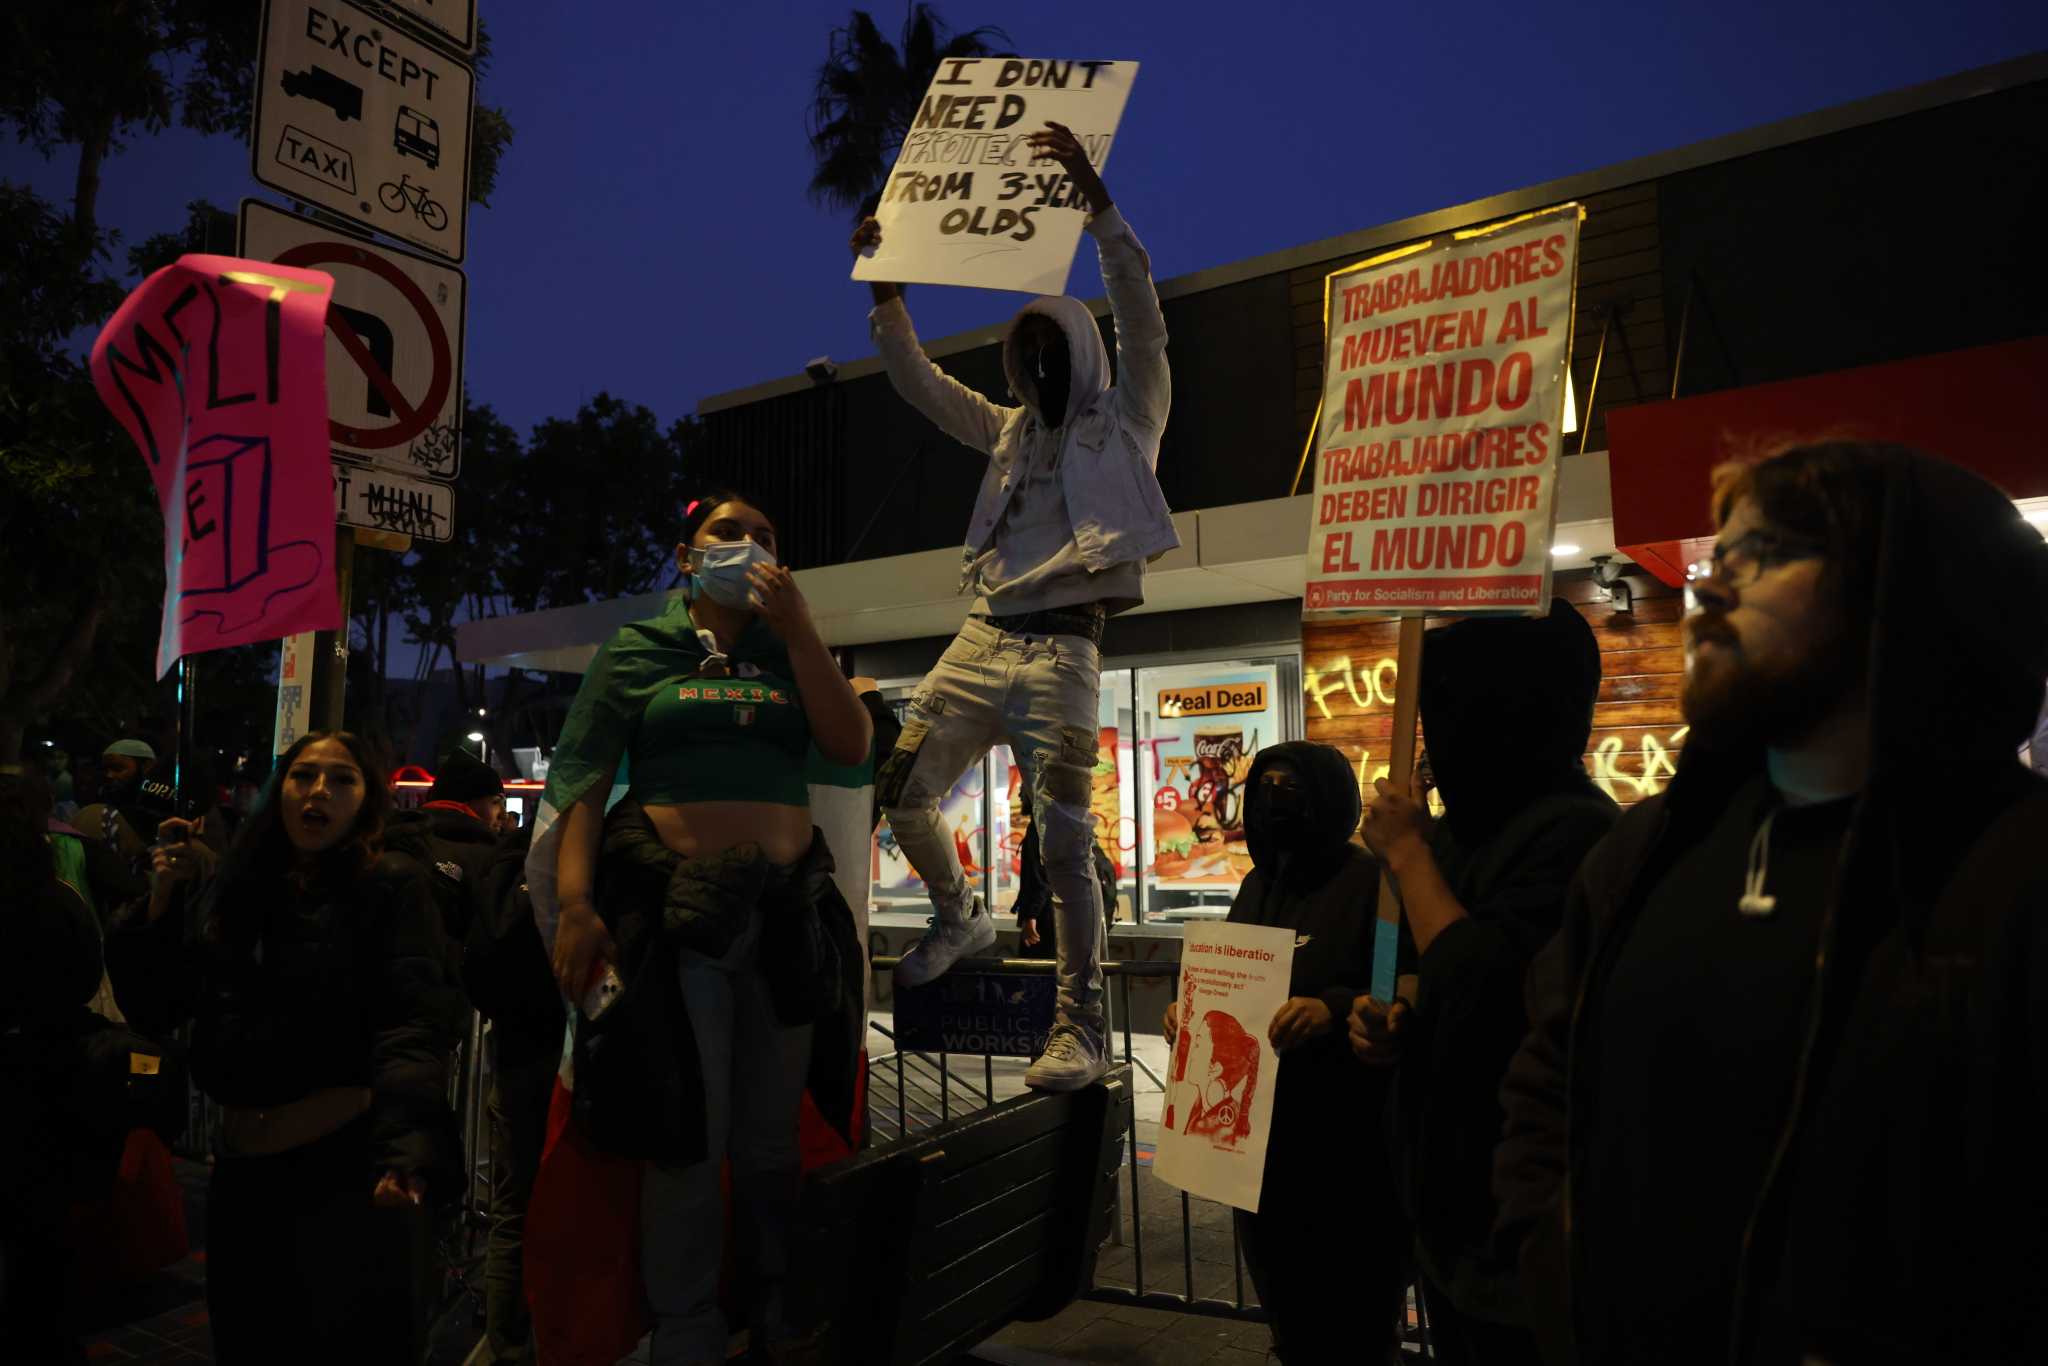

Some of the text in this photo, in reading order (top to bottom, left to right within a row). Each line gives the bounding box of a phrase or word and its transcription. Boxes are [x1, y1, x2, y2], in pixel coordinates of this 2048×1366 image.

[306, 9, 439, 100] EXCEPT
[936, 60, 981, 85] I
[917, 94, 1026, 129] NEED
[287, 138, 349, 182] TAXI
[887, 171, 974, 203] FROM
[940, 206, 1040, 241] OLDS
[1342, 234, 1567, 324] TRABAJADORES
[1340, 296, 1548, 372] MUEVEN AL
[1343, 352, 1533, 433] MUNDO
[1323, 423, 1549, 486] TRABAJADORES
[1319, 475, 1540, 526] DEBEN DIRIGIR
[1324, 521, 1526, 574] EL MUNDO
[1327, 584, 1539, 604] Party for Socialism and Liberation
[1217, 687, 1262, 708] Deal
[1215, 944, 1223, 955] is
[942, 1014, 1032, 1033] PUBLIC
[941, 1034, 1032, 1053] WORKS
